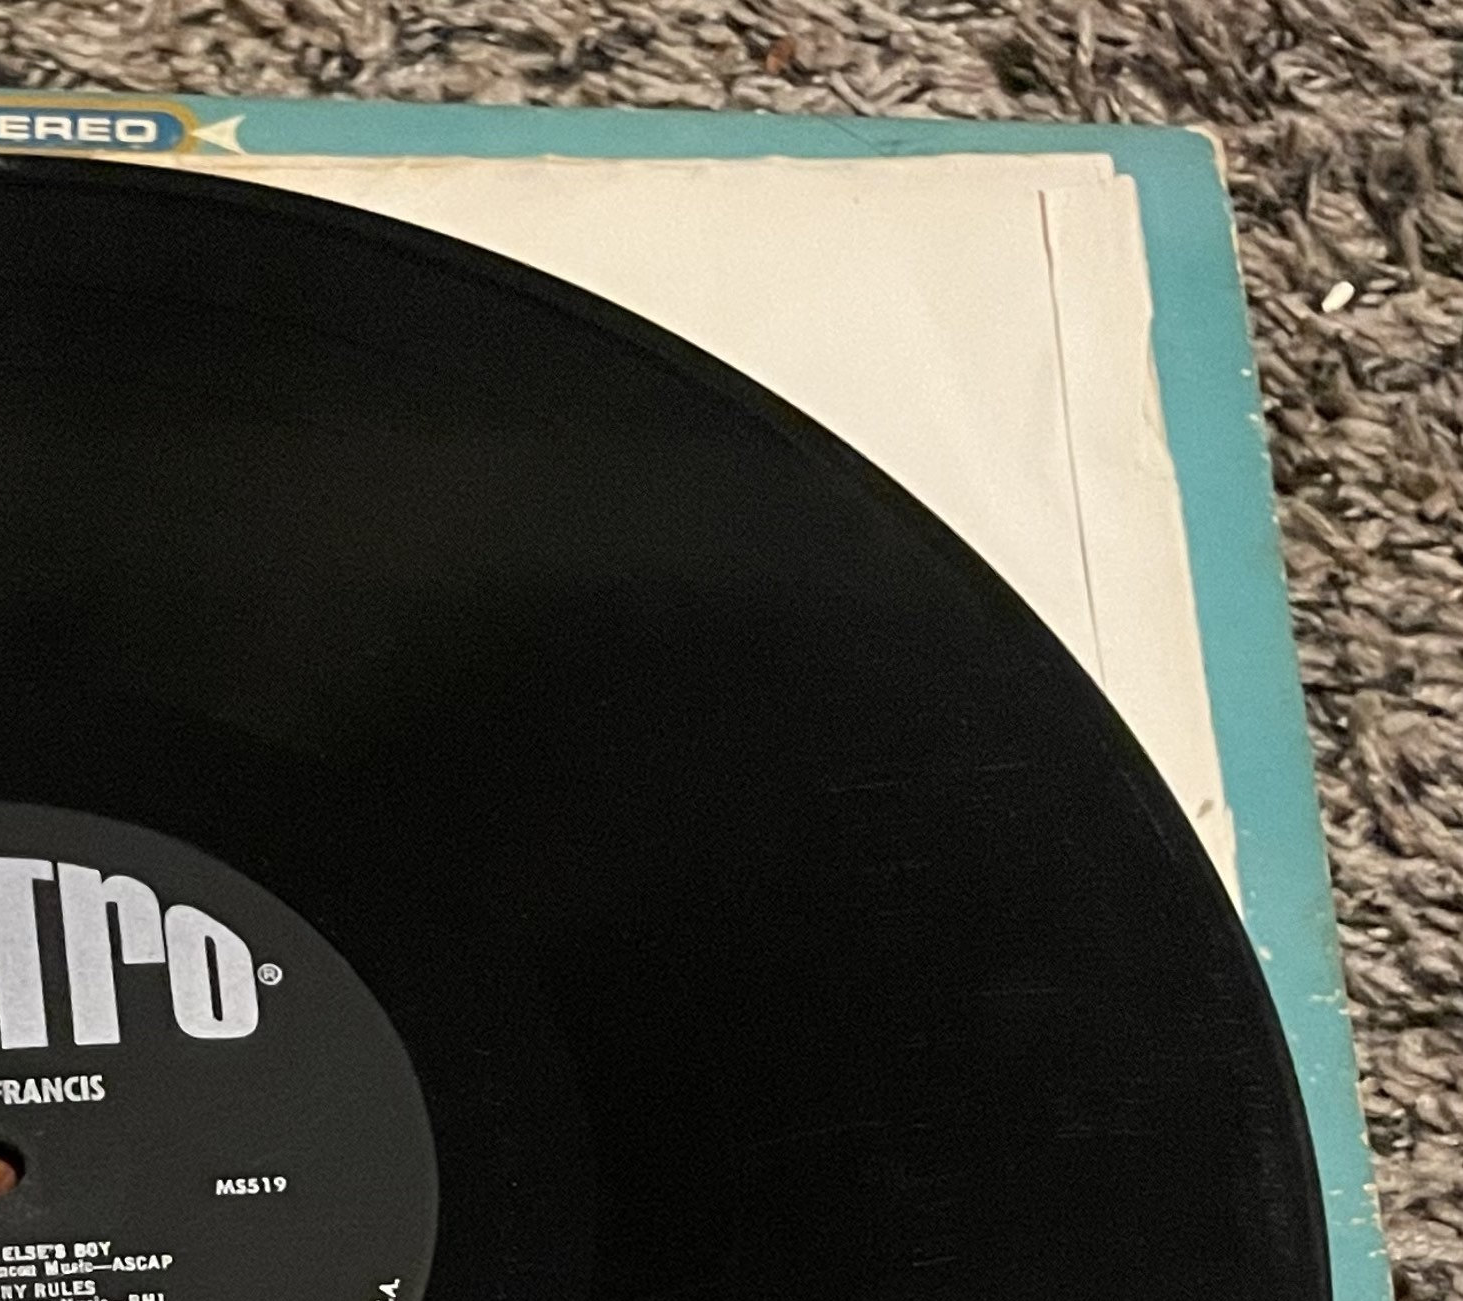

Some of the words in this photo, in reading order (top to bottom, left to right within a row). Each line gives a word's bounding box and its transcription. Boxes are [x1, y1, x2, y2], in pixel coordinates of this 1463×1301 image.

[215, 1175, 288, 1196] MS519
[2, 1243, 66, 1262] ELSE'S
[73, 1241, 111, 1258] BOY
[34, 1280, 96, 1299] RULES
